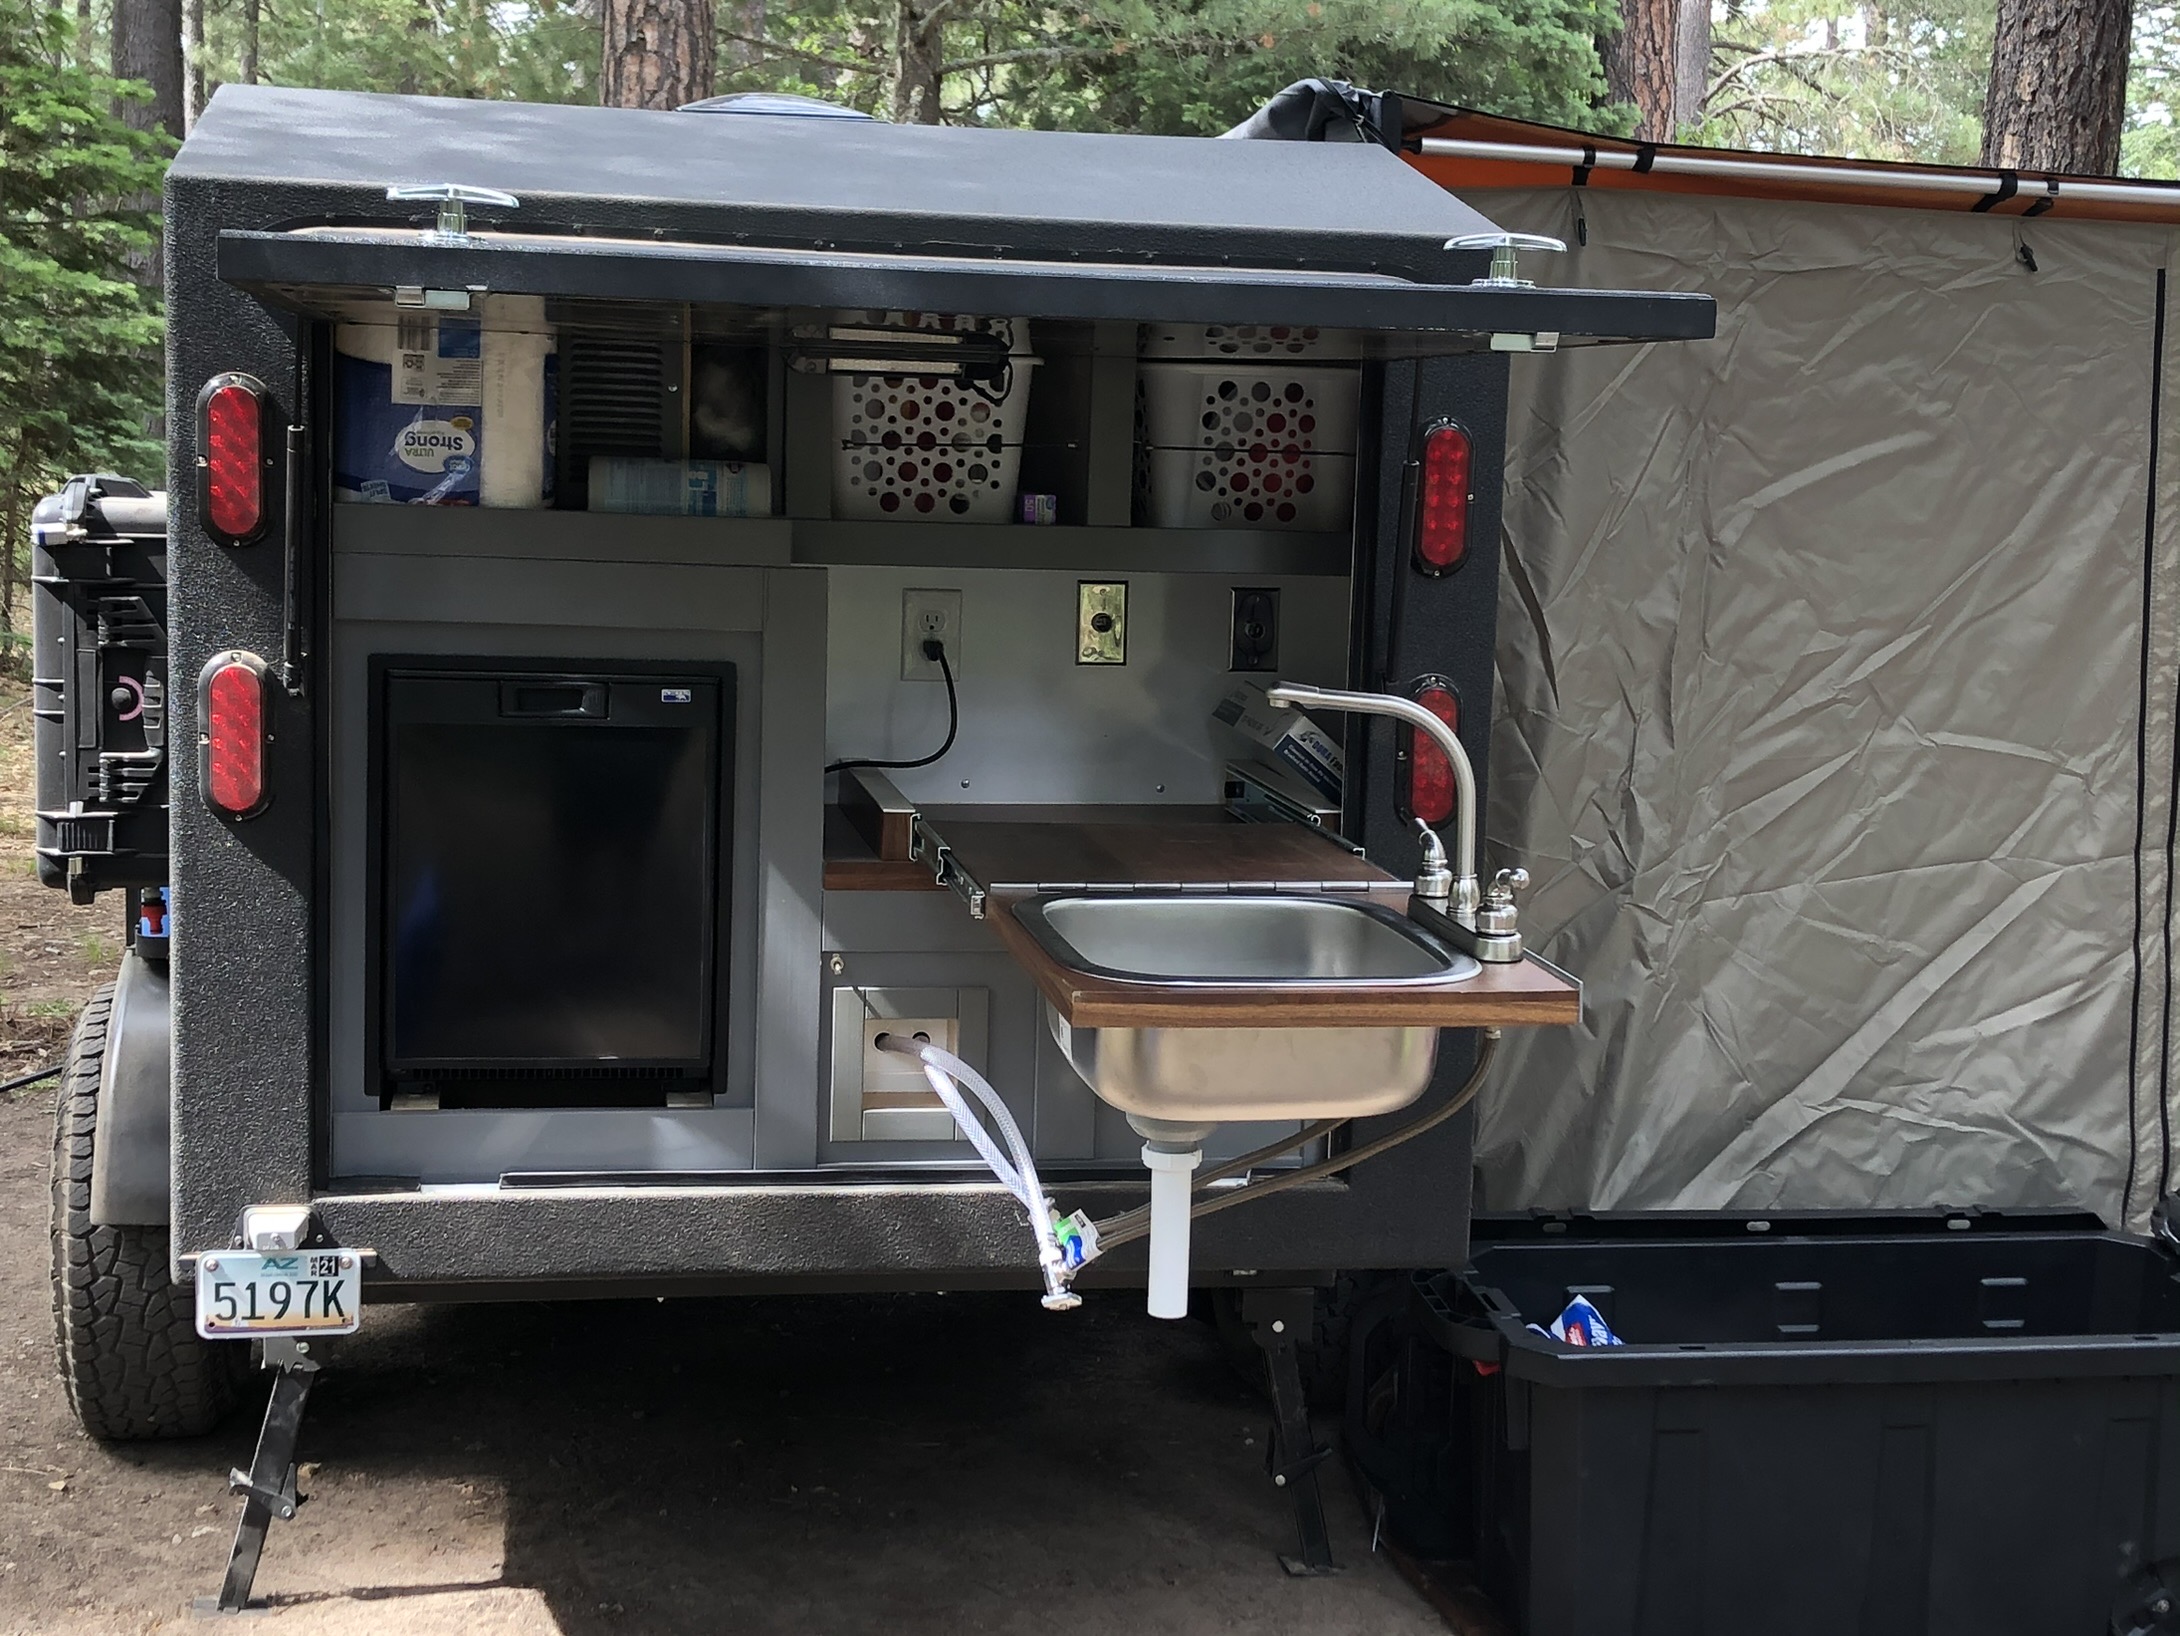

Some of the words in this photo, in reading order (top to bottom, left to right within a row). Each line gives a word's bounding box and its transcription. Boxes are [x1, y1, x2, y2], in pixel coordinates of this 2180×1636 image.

[404, 431, 464, 451] Strong
[404, 447, 434, 457] ULTRA
[261, 1257, 299, 1270] AZ
[310, 1256, 318, 1277] MAR
[320, 1259, 336, 1275] 21
[214, 1280, 346, 1321] 5197K
